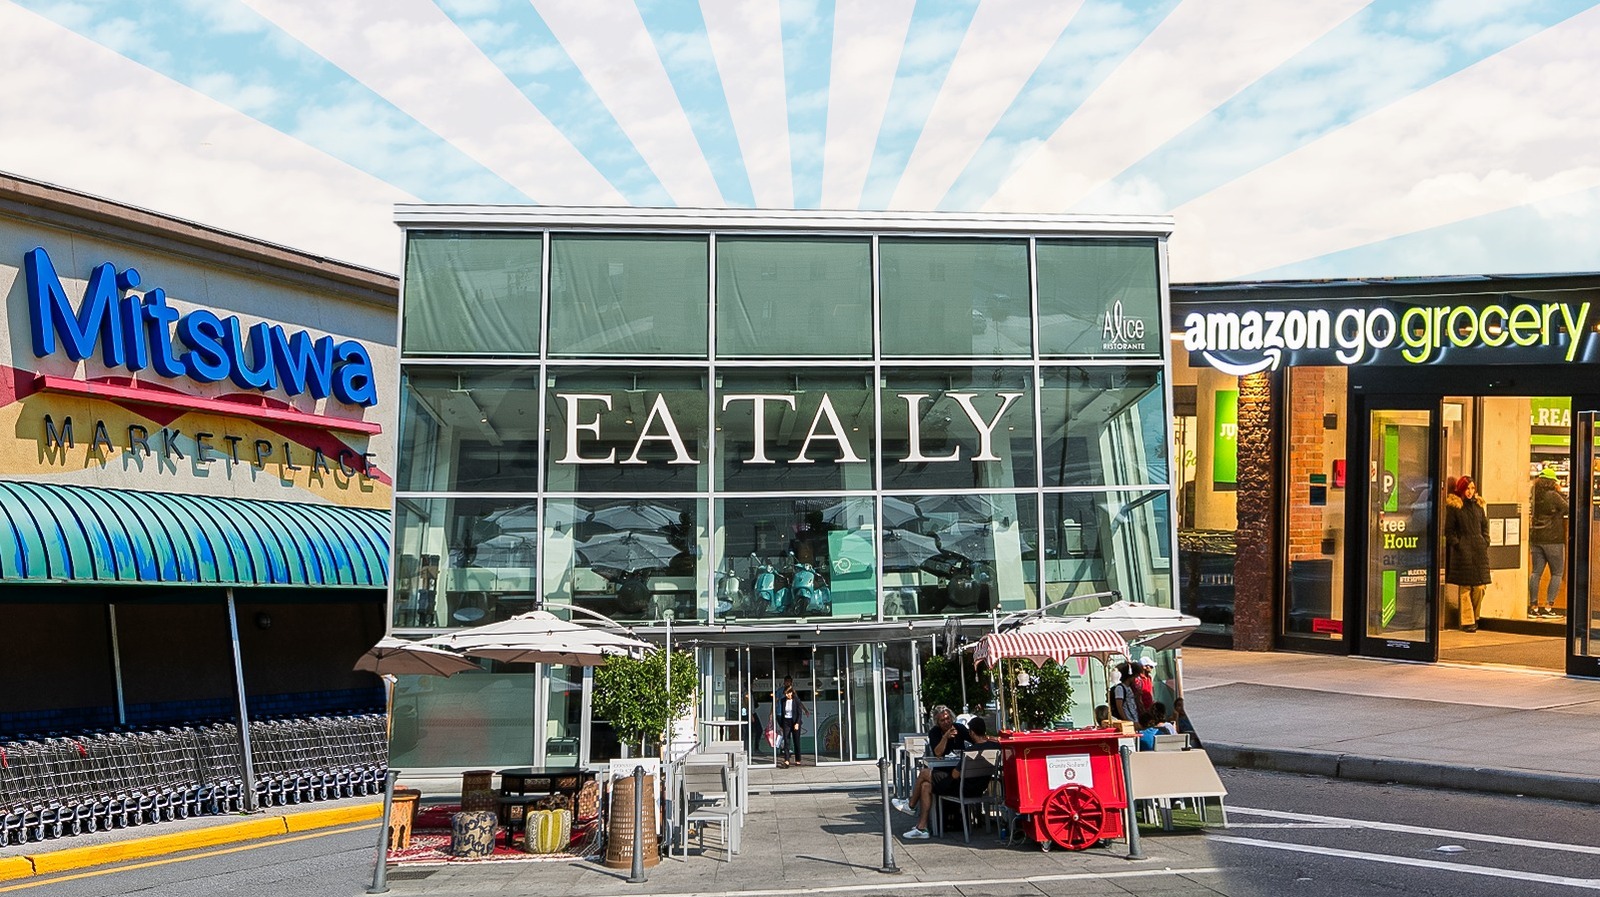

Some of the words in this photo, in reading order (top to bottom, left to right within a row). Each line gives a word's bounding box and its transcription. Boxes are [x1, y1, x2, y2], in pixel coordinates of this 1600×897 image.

[24, 246, 378, 407] Mitsuwa
[1103, 300, 1145, 343] Alice
[1183, 309, 1330, 352] amazon
[1335, 308, 1397, 364] go
[1401, 302, 1591, 364] grocery
[45, 413, 380, 480] MARKETPLACE
[555, 392, 1024, 465] EATALY
[1383, 534, 1418, 549] Hour
